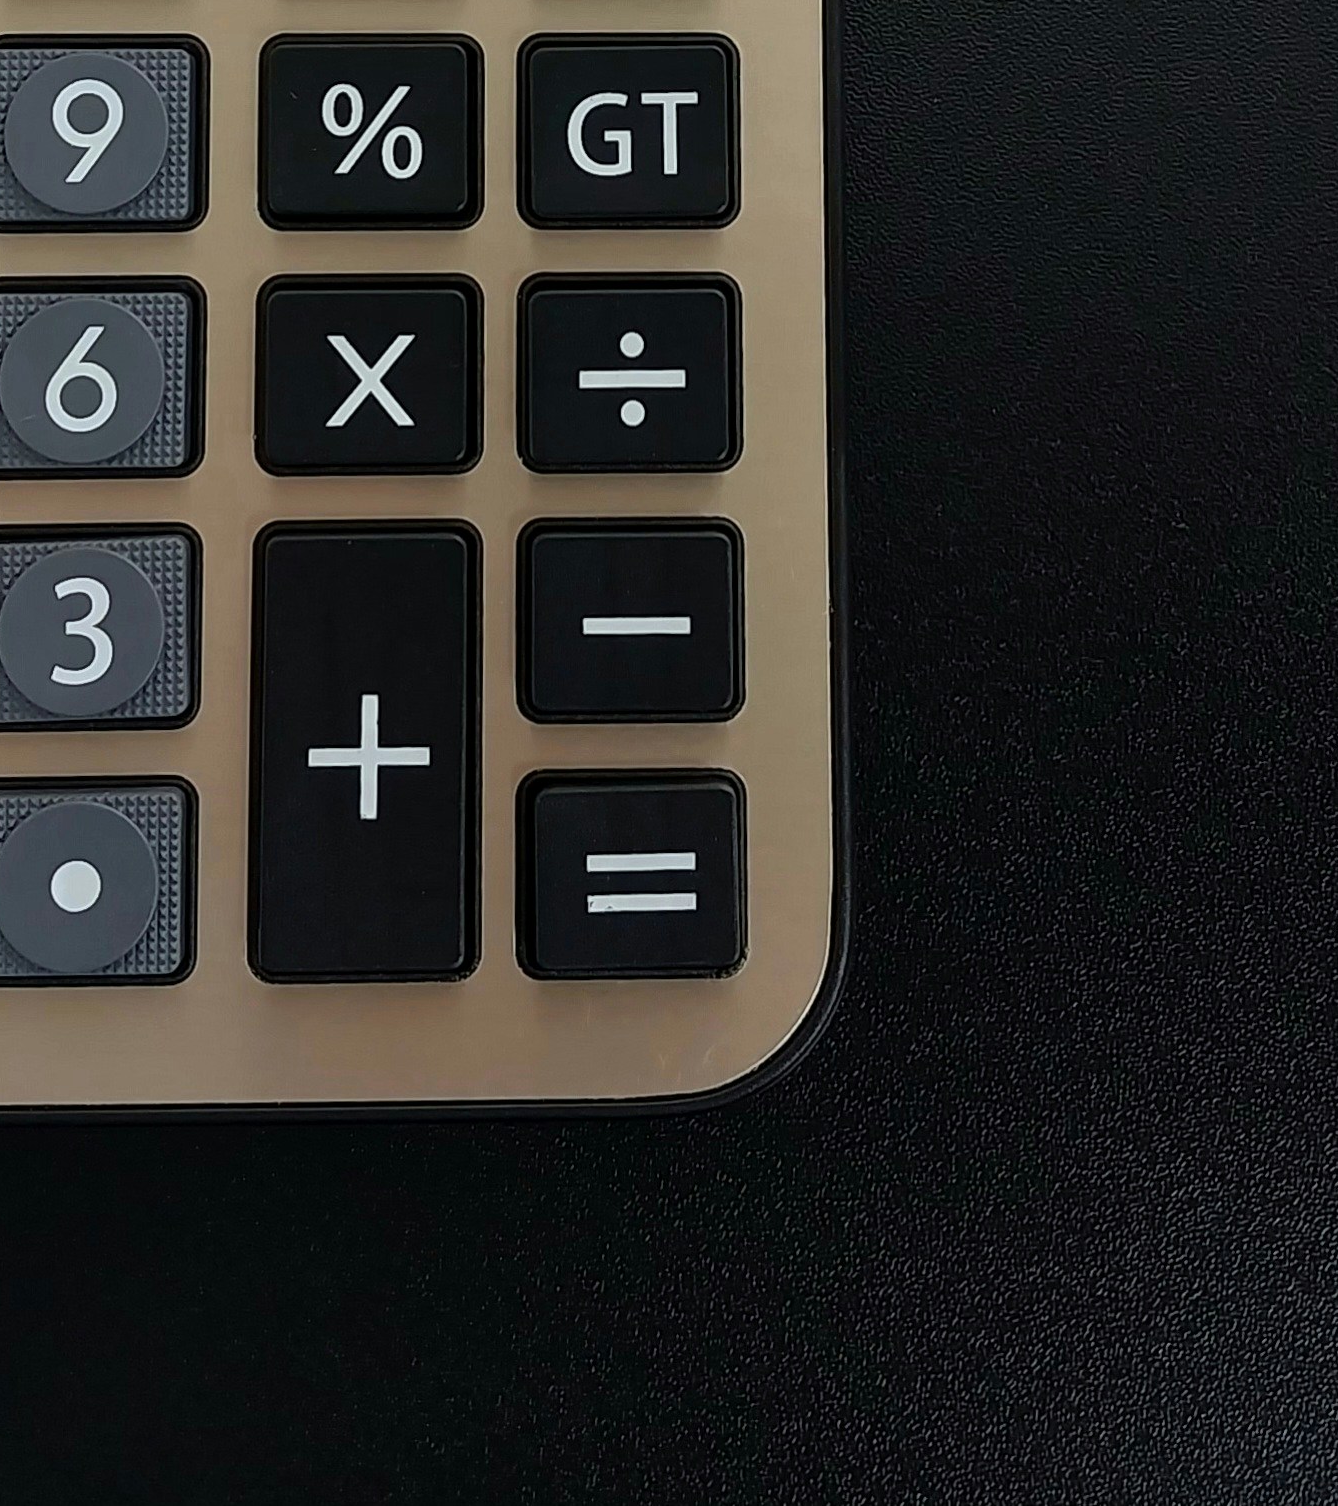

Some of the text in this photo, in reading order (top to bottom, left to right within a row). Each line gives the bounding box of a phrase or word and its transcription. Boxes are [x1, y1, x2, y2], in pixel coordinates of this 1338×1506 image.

[52, 79, 124, 183] 9
[567, 91, 699, 176] GT
[45, 326, 117, 433] 6
[50, 577, 113, 686] 3
